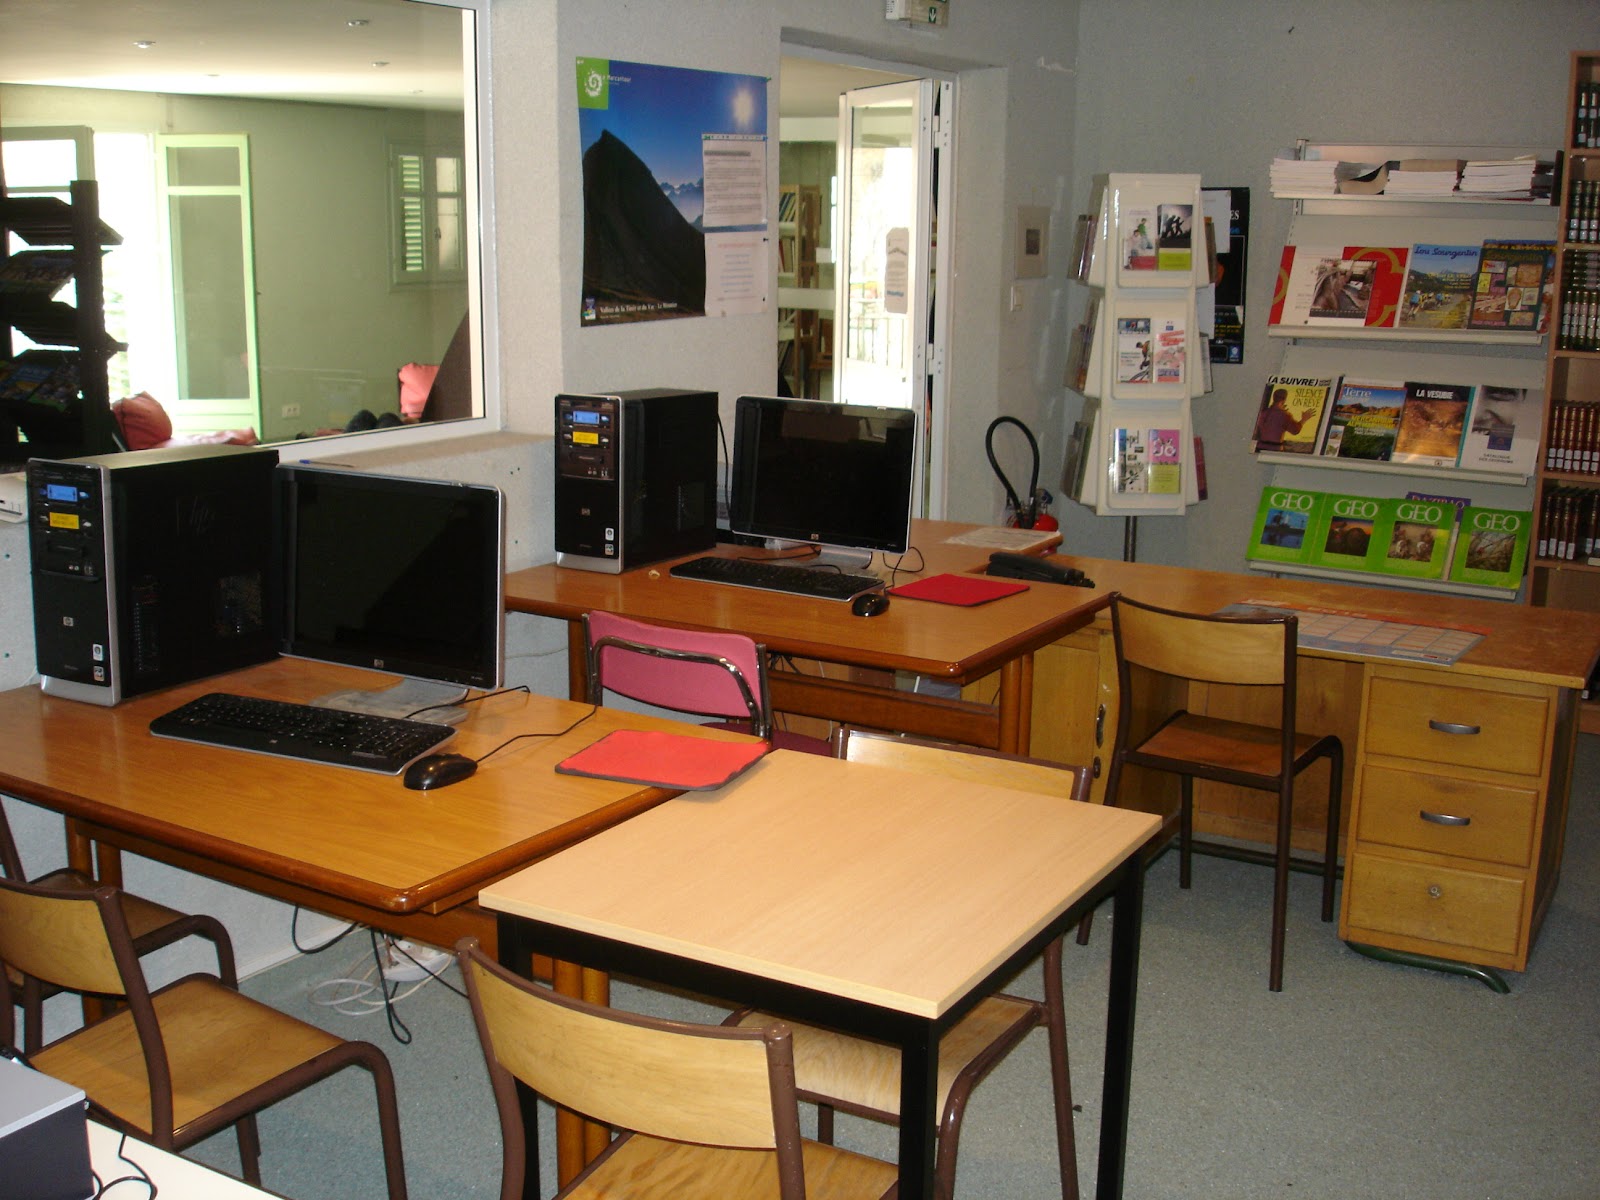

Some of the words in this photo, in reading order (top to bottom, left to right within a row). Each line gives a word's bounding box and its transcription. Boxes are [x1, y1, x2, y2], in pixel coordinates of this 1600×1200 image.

[1280, 377, 1319, 387] SUIVRE)
[1295, 388, 1324, 398] SILENCE
[1344, 386, 1372, 398] Terre
[1415, 388, 1425, 398] LA
[1270, 491, 1314, 511] GEO
[1333, 498, 1379, 518] GEO
[1396, 503, 1443, 523] GEO
[1473, 512, 1521, 532] GEO
